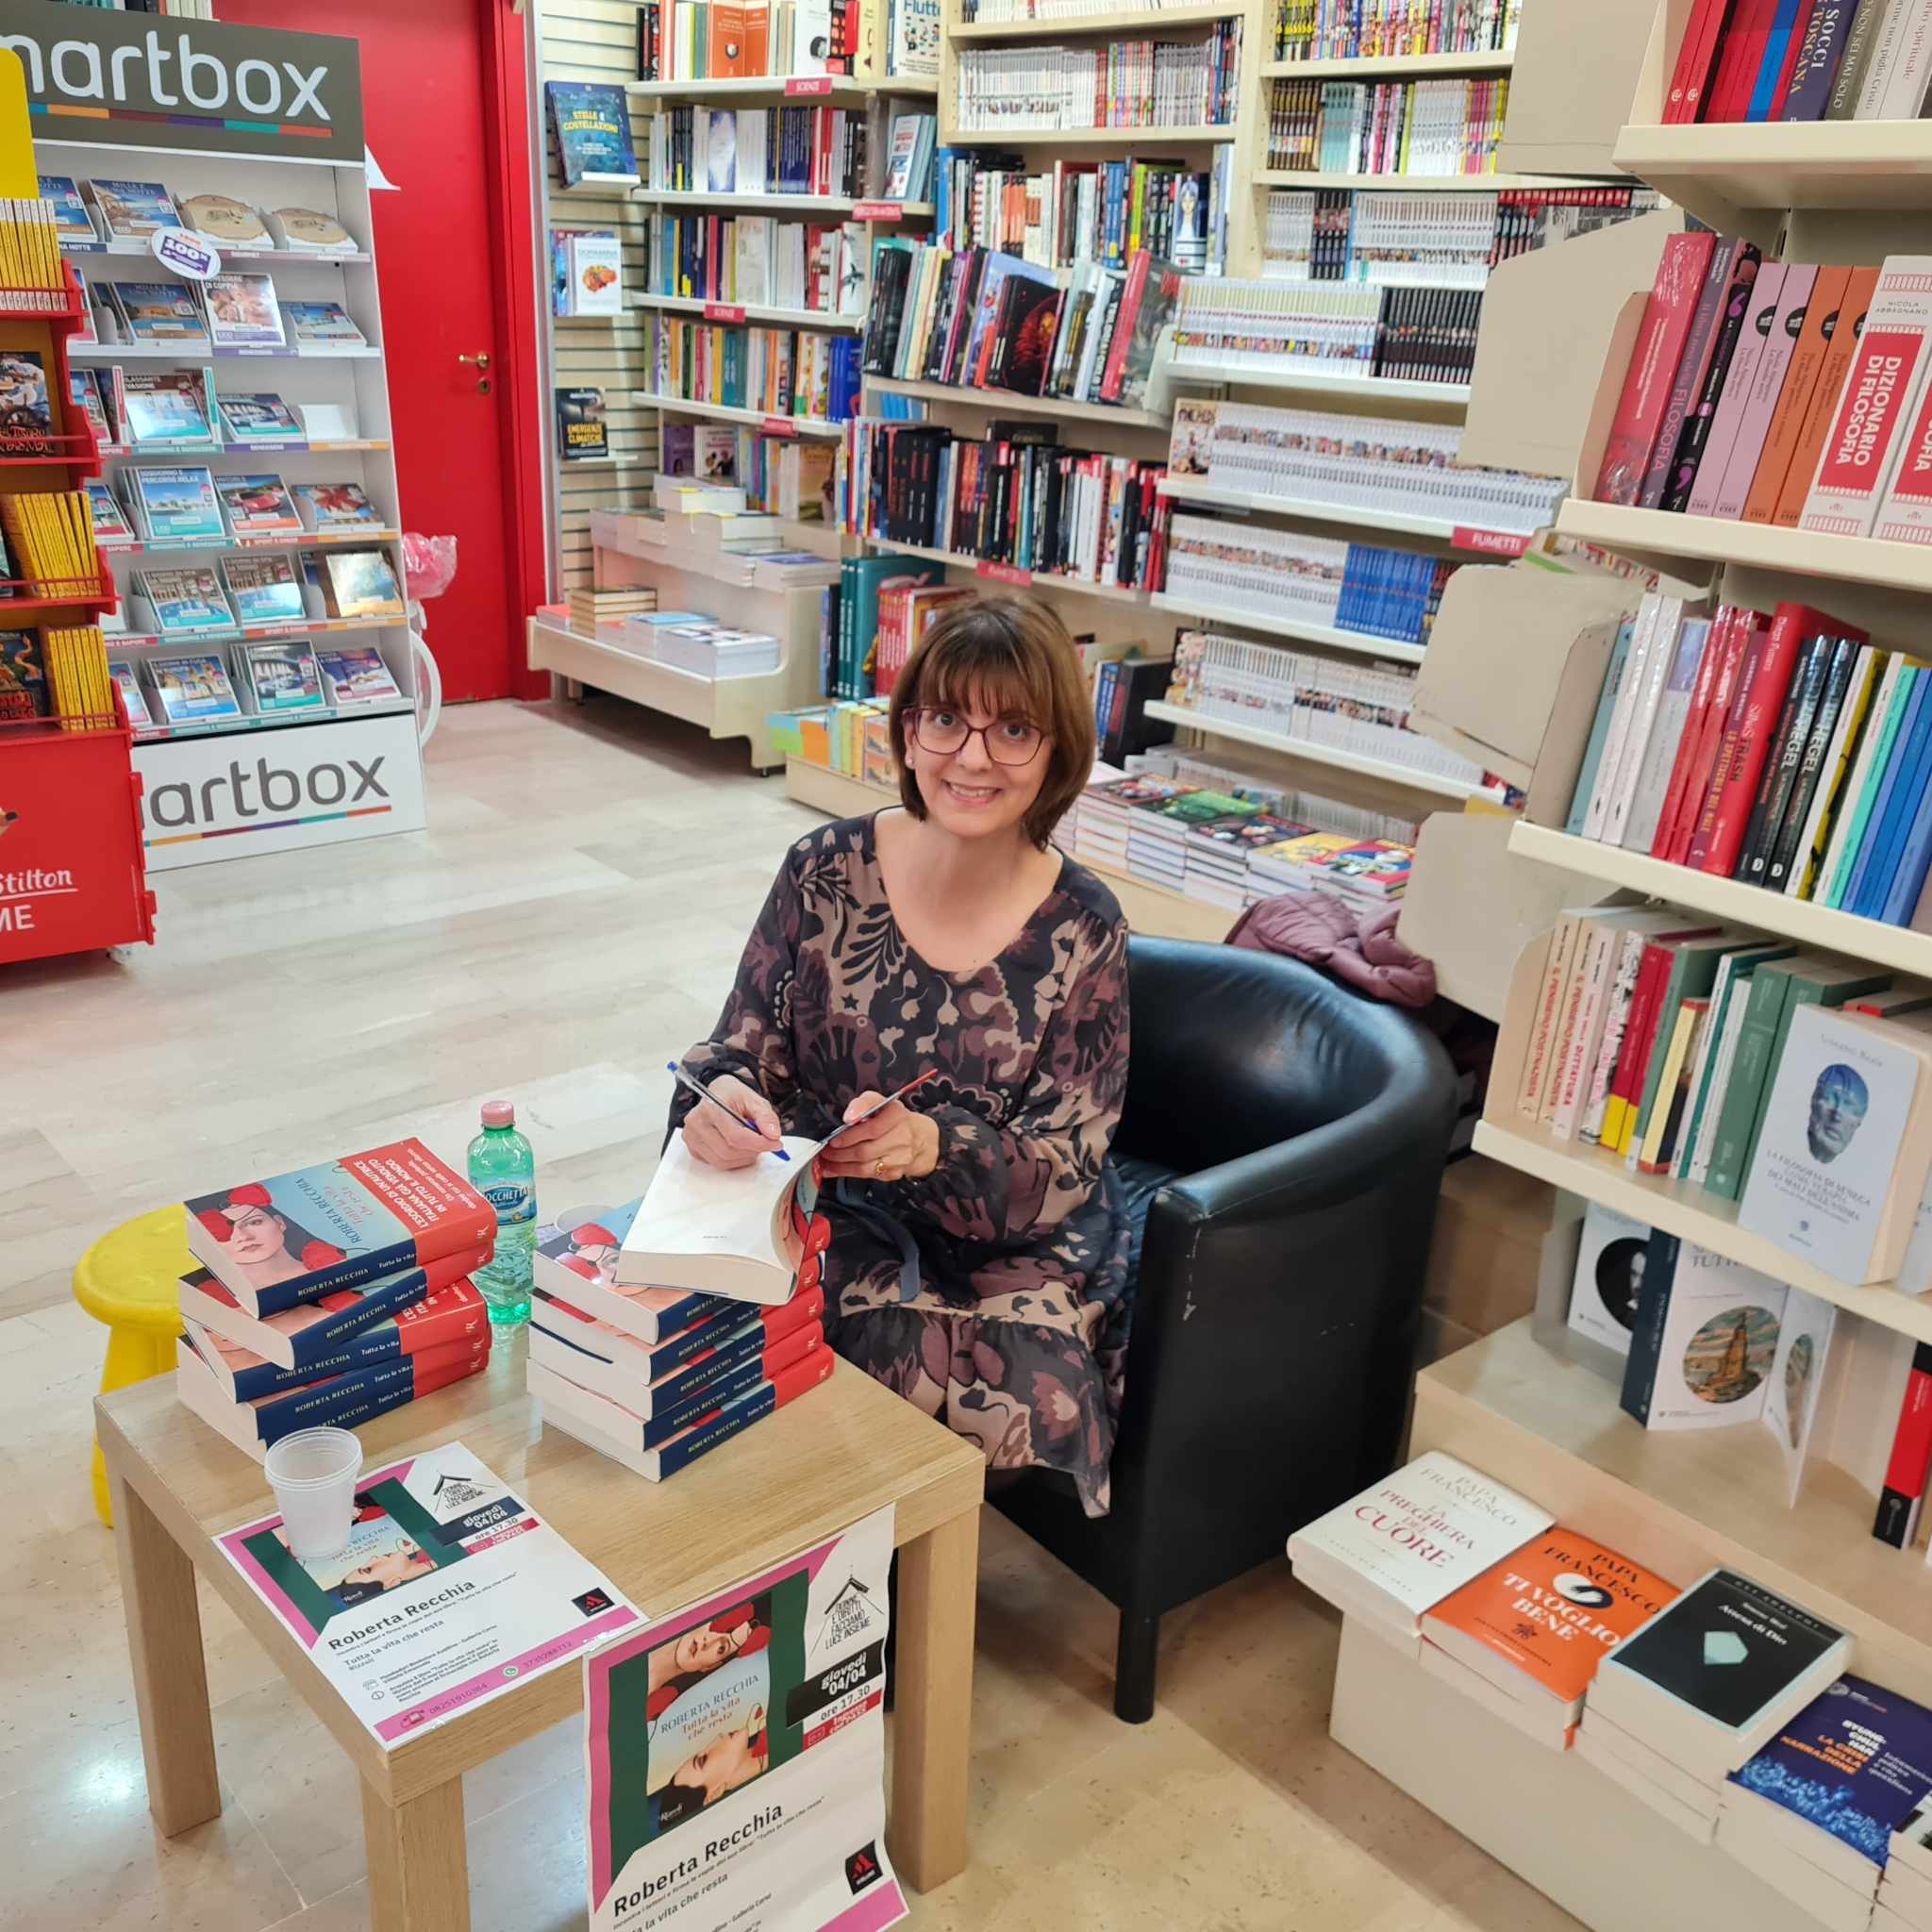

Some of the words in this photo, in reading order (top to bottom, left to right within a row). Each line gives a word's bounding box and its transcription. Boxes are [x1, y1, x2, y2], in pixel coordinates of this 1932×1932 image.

[1833, 77, 1850, 109] SOLO
[1867, 354, 1885, 375] DI
[1835, 375, 1881, 465] FILOSOFIA
[1854, 356, 1903, 467] DIZIONARIO
[1652, 388, 1689, 472] FILOSOFIA
[1471, 533, 1522, 552] FUMETTI
[1801, 724, 1828, 774] HEGEL
[295, 1177, 330, 1210] RECCHIA
[485, 1185, 529, 1202] OCCHETTA
[325, 1204, 363, 1244] ROBERTA
[378, 1259, 394, 1269] Tutta
[297, 1279, 333, 1297] ROBERTA
[335, 1267, 369, 1285] RECCHIA
[325, 1319, 358, 1339] ROBERTA
[358, 1303, 388, 1321] RECCHIA
[361, 1346, 377, 1357] Tutta
[678, 1338, 705, 1357] ROBERTA
[705, 1324, 730, 1341] RECCHIA
[275, 1364, 314, 1381] ROBERTA
[315, 1353, 352, 1371] RECCHIA
[375, 1374, 391, 1384] Tutta
[679, 1373, 707, 1392] ROBERTA
[708, 1357, 732, 1375] RECCHIA
[294, 1396, 330, 1414] ROBERTA
[331, 1381, 365, 1400] RECCHIA
[338, 1402, 370, 1423] RECCHIA
[378, 1393, 394, 1406] Tutta
[674, 1406, 700, 1425] ROBERTA
[701, 1391, 727, 1409] RECCHIA
[688, 1433, 715, 1453] ROBERTA
[715, 1418, 741, 1437] RECCHIA
[1420, 1467, 1519, 1526] FRANCESCO
[1456, 1475, 1499, 1505] PAPA
[474, 1509, 508, 1528] 04/04
[1380, 1489, 1476, 1551] PREGHIERA
[1355, 1505, 1455, 1569] CUORE
[1543, 1547, 1661, 1615] FRANCESCO
[1592, 1553, 1639, 1584] PAPA
[328, 1611, 403, 1652] Roberta
[404, 1580, 476, 1618] Recchia
[1504, 1572, 1532, 1592] TI
[1532, 1586, 1622, 1646] VOGLIO
[1512, 1597, 1580, 1641] BENE
[1718, 1605, 1753, 1626] Attesa
[1753, 1623, 1766, 1634] di
[1766, 1629, 1788, 1645] Dio
[344, 1650, 371, 1668] Tutta
[371, 1646, 382, 1657] la
[382, 1638, 403, 1651] vita
[402, 1630, 419, 1642] che
[419, 1619, 445, 1635] resta
[828, 1665, 867, 1696] 04/04
[660, 1701, 710, 1734] ROBERTA
[713, 1674, 759, 1705] RECCHIA
[821, 1705, 838, 1722] ore
[841, 1684, 871, 1709] 17.30
[681, 1714, 708, 1734] Tutta
[1780, 1735, 1857, 1775] NARRAZIONE
[1816, 1734, 1834, 1746] LA
[1836, 1742, 1870, 1763] CRISI
[1824, 1745, 1862, 1769] DELLA
[1847, 1740, 1875, 1757] HAN
[614, 1856, 699, 1918] Roberta
[705, 1803, 783, 1862] Recchia
[657, 1906, 678, 1923] vita
[679, 1891, 700, 1908] che
[701, 1873, 728, 1895] resta
